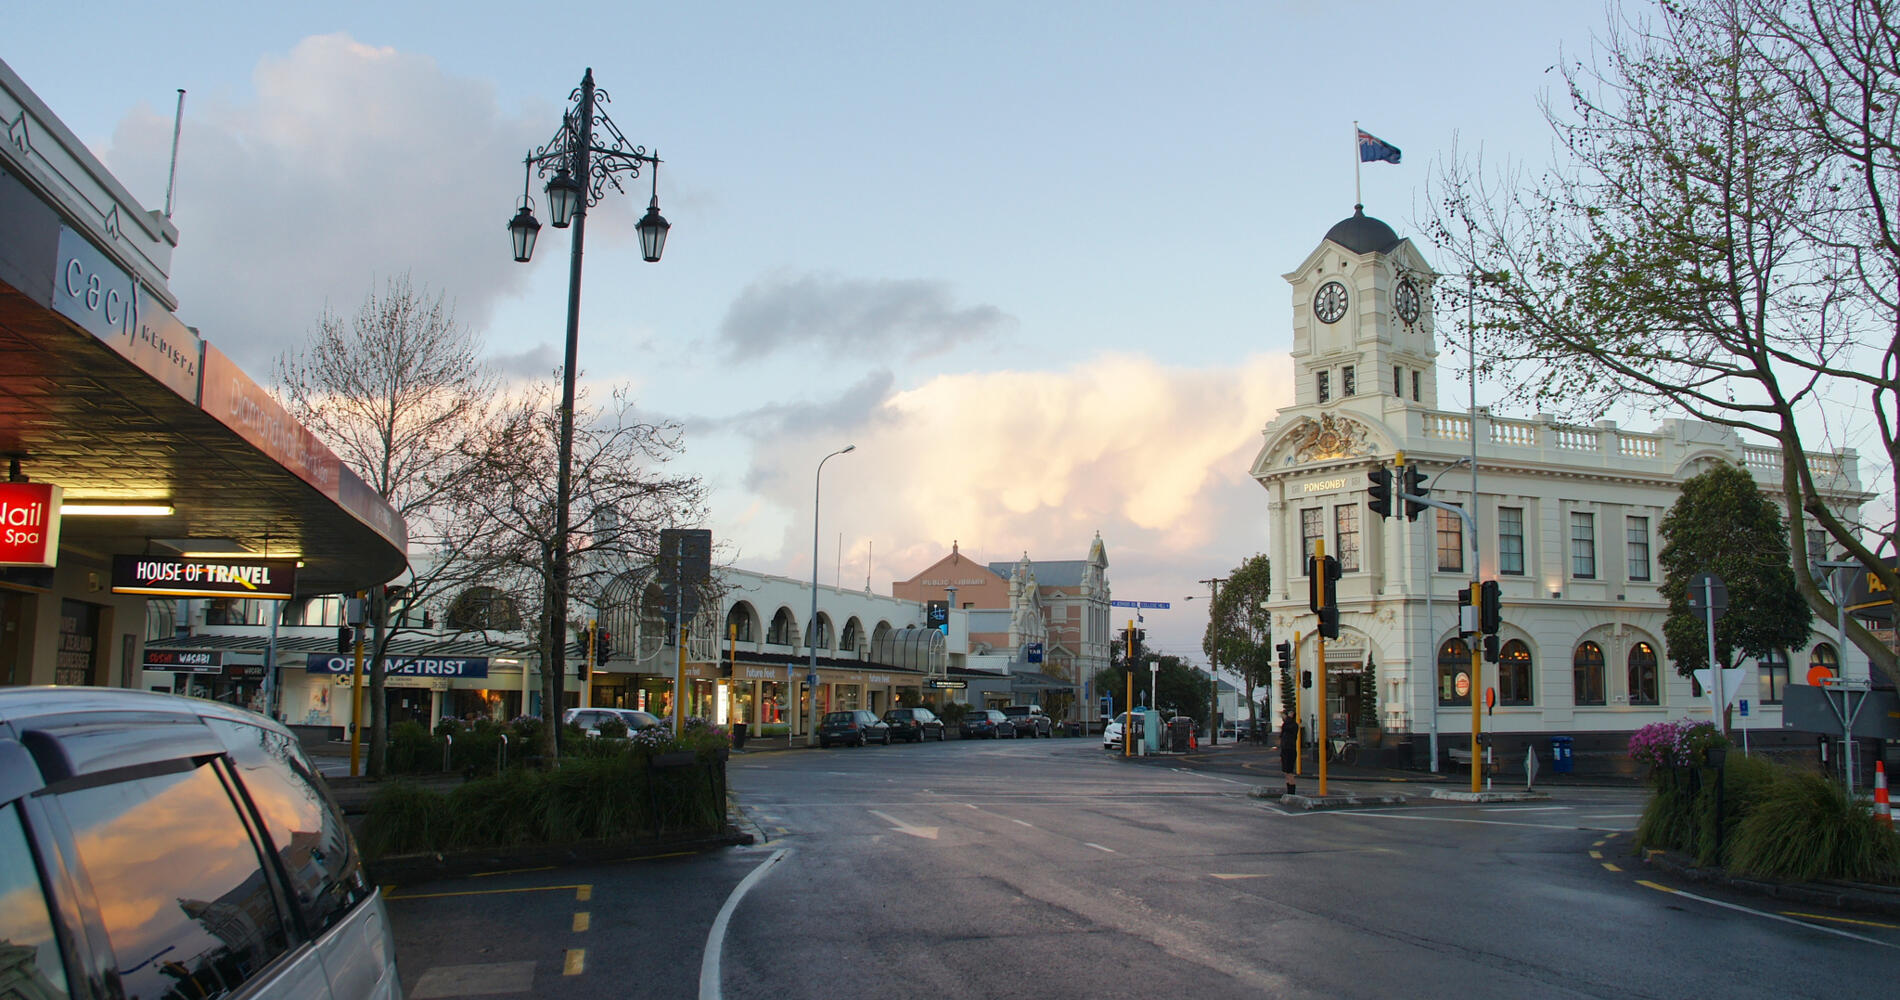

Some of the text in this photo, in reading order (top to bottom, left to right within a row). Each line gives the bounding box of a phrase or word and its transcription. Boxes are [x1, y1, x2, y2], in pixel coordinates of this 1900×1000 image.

[1303, 478, 1346, 492] PONSONBY
[5, 529, 39, 546] Spa
[136, 561, 271, 584] HOUSE OF TRAVEL
[179, 653, 211, 664] WASABI
